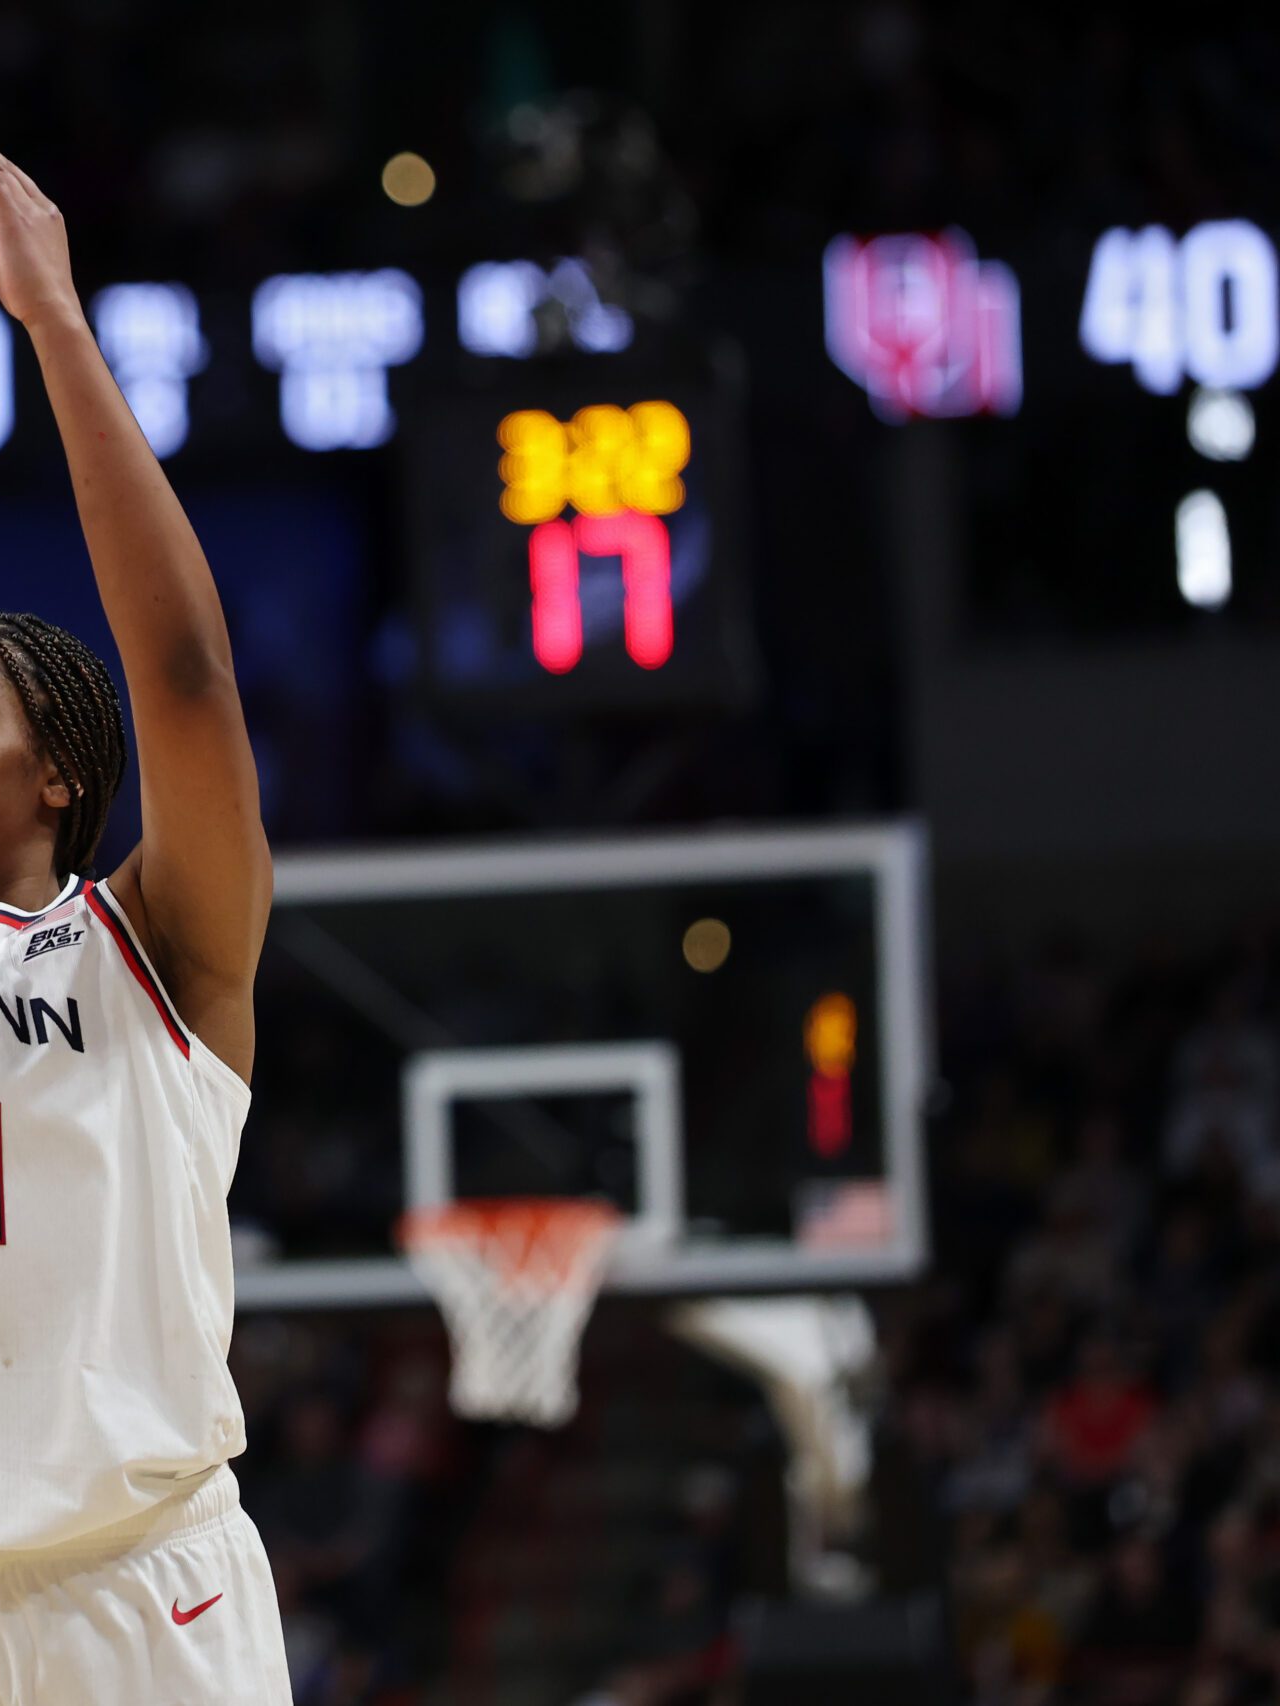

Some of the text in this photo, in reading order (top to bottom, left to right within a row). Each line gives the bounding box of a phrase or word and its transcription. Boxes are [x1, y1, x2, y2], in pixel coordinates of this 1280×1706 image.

[1079, 218, 1280, 396] 40
[529, 508, 674, 675] 17
[25, 930, 85, 956] EAST
[29, 922, 71, 946] BIG
